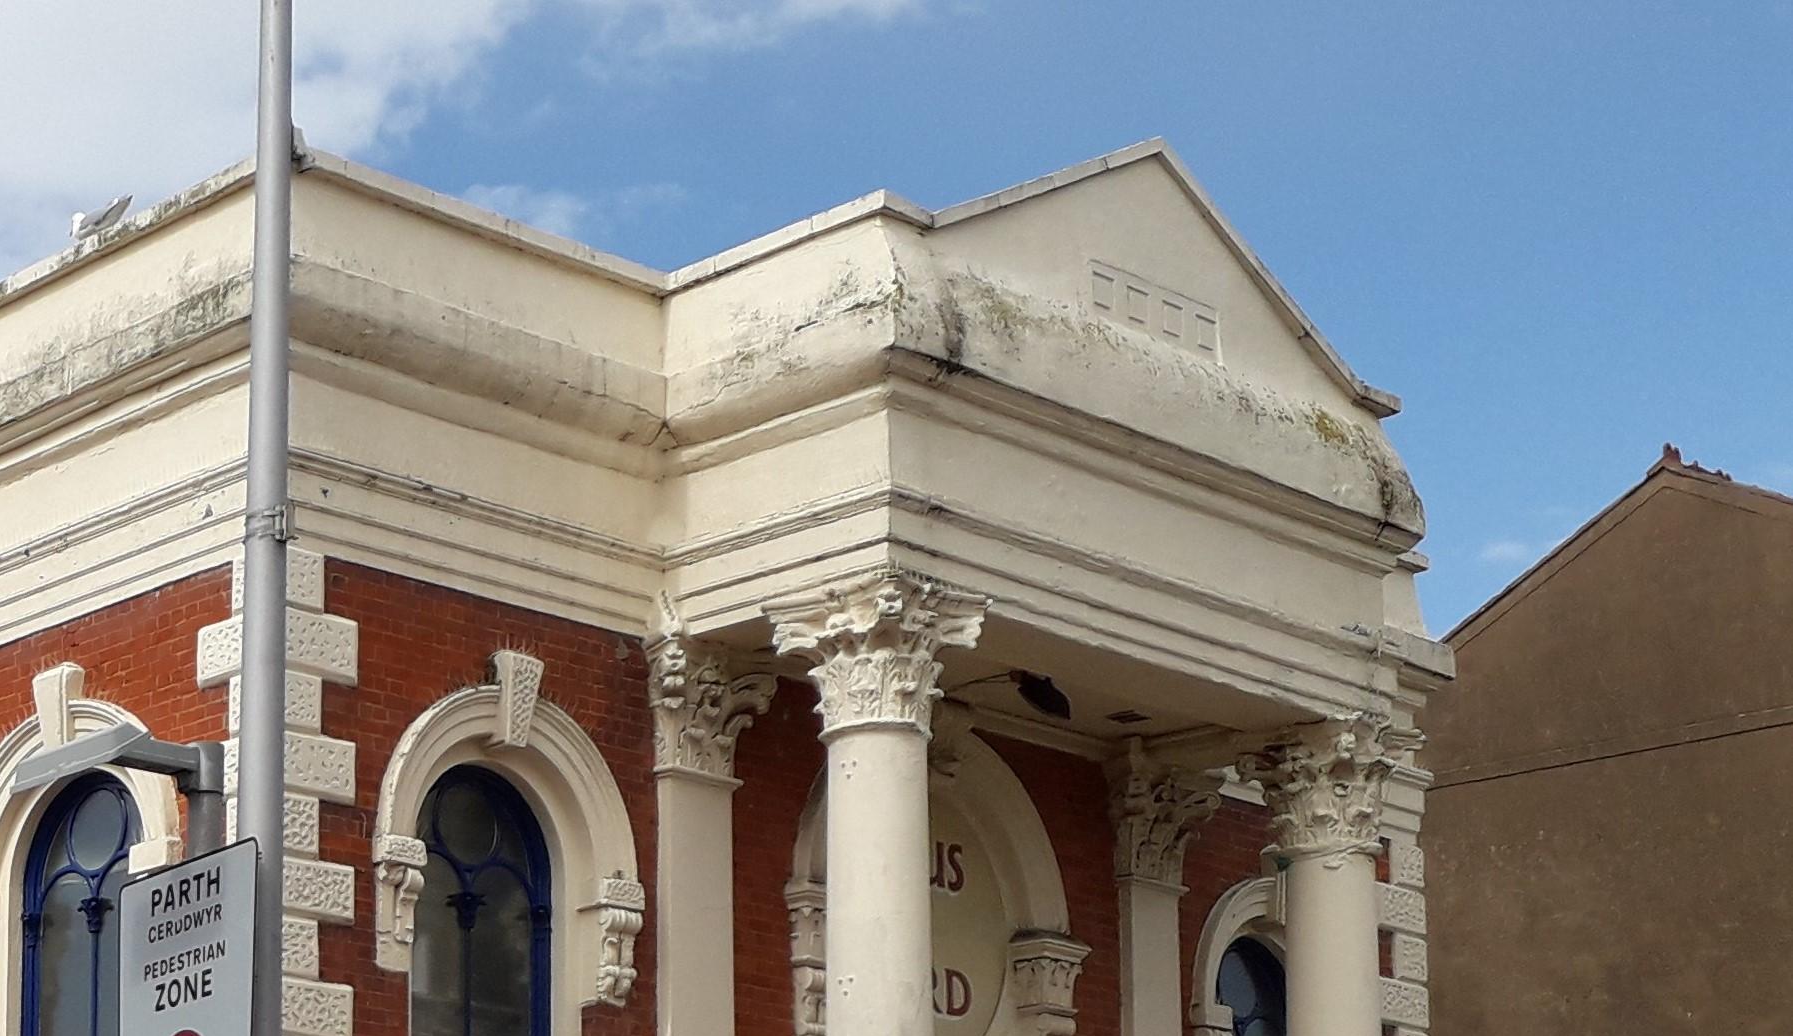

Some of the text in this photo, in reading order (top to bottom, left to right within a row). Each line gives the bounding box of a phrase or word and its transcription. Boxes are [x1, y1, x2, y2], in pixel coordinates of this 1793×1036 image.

[150, 865, 221, 917] PARTH
[148, 903, 223, 943] CERUDWYR
[143, 939, 226, 982] PEDESTRIAN
[154, 967, 213, 1012] ZONE
